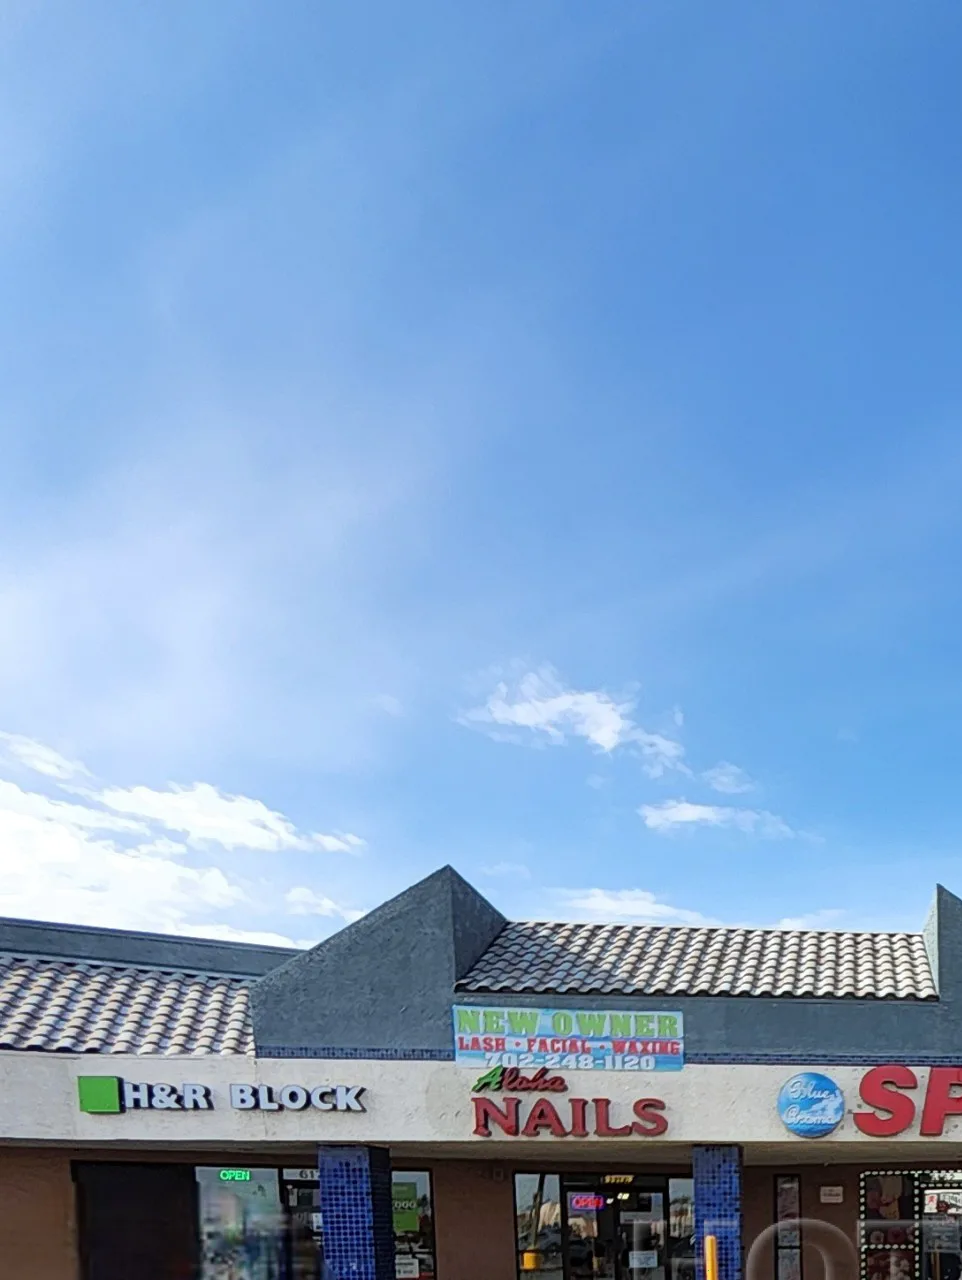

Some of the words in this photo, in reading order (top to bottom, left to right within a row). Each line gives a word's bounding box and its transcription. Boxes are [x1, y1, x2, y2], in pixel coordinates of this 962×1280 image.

[457, 1010, 540, 1033] NEW
[552, 1012, 678, 1037] OWNER
[458, 1037, 506, 1052] LASH
[527, 1038, 591, 1053] FACIAL
[612, 1041, 682, 1055] WAXING
[472, 1065, 568, 1093] Aloha
[123, 1082, 213, 1111] H&R
[230, 1084, 366, 1112] BLOCK
[471, 1097, 669, 1137] NAILS
[220, 1170, 250, 1181] OPEN
